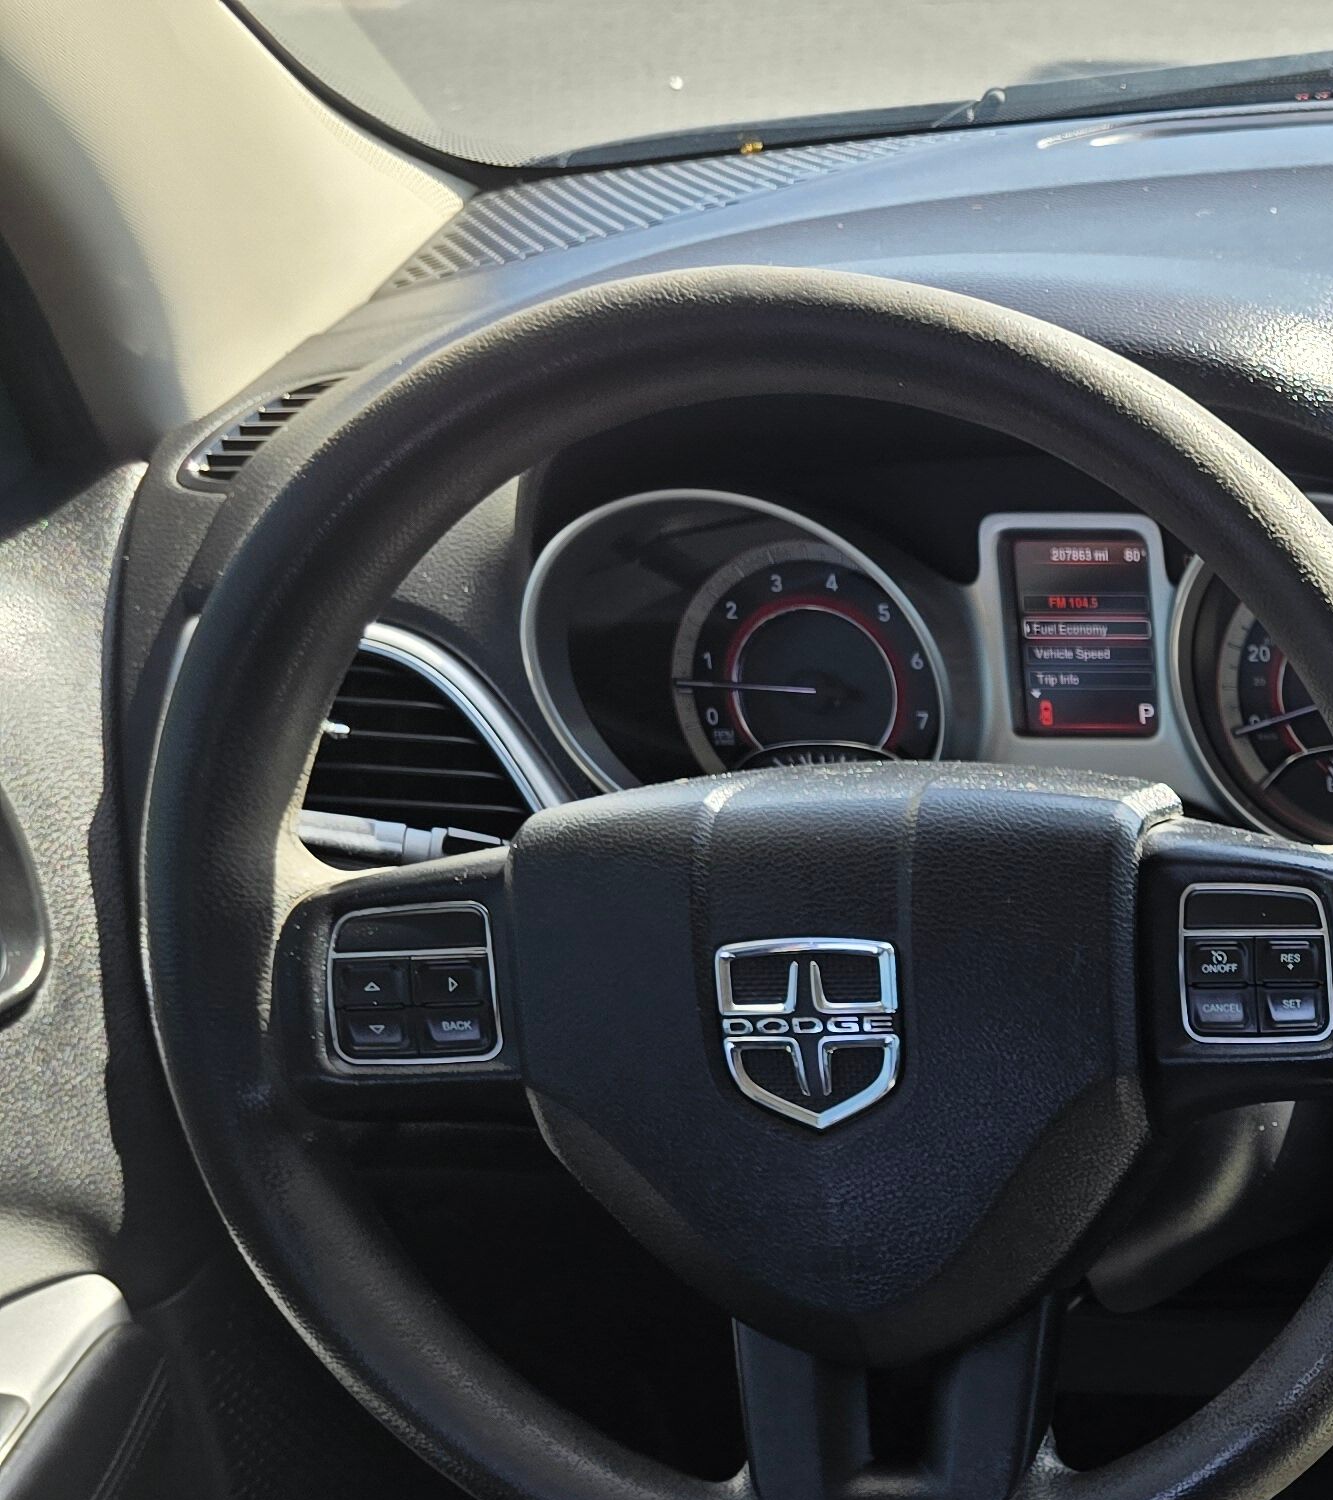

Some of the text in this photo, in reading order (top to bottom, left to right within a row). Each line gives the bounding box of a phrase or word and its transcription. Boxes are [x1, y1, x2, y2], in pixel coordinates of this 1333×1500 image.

[1094, 548, 1109, 562] mi
[770, 575, 783, 593] 3
[825, 574, 839, 593] 4
[1048, 597, 1099, 608] FM 104.5
[725, 603, 739, 620] 2
[877, 605, 891, 622] 5
[1033, 623, 1108, 638] Fuel Economy
[703, 652, 713, 670] 1
[911, 653, 924, 671] 6
[1034, 648, 1111, 662] Vehicle Speed
[1248, 645, 1271, 662] 20
[1037, 674, 1080, 686] Trip Info
[705, 708, 720, 727] 0
[916, 711, 930, 731] 7
[1139, 703, 1155, 724] P
[1280, 954, 1301, 963] RES
[1201, 964, 1238, 973] ON/OFF
[1202, 1003, 1241, 1013] CANCEL
[1282, 1000, 1302, 1009] SET
[442, 1020, 472, 1031] BACK
[722, 1016, 893, 1035] DODGE
